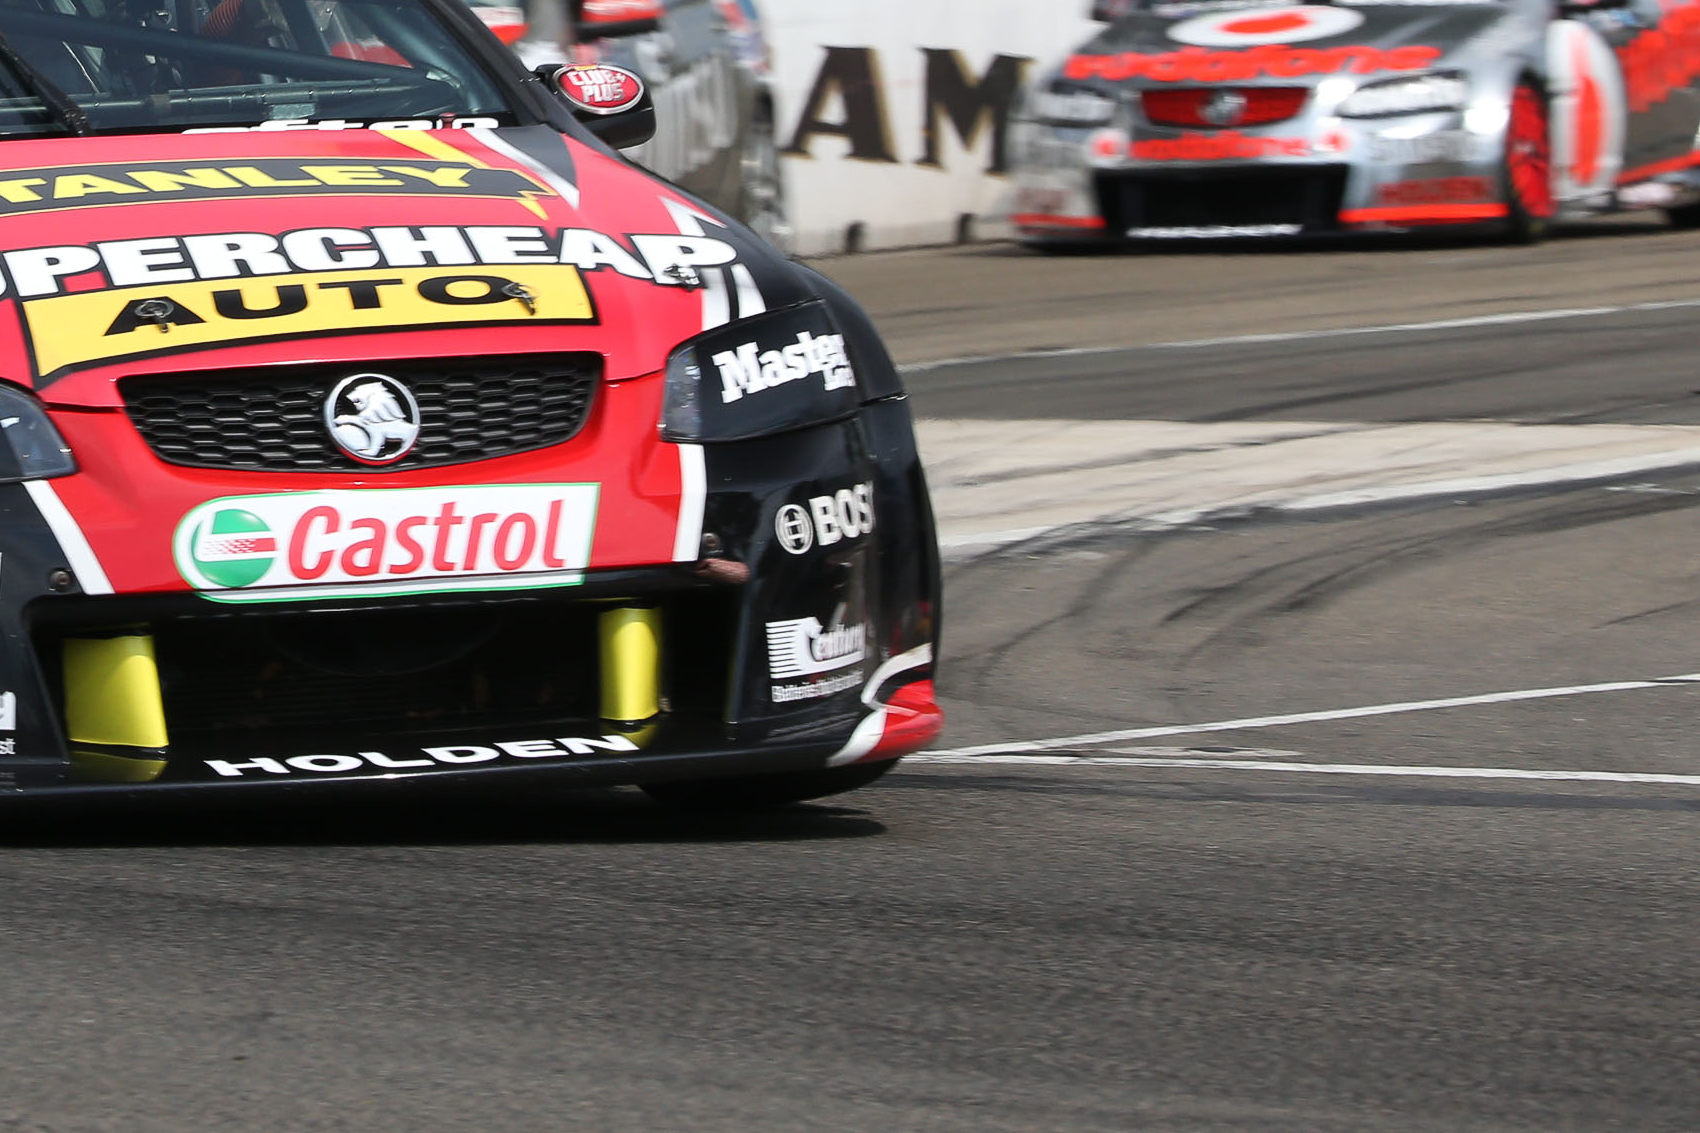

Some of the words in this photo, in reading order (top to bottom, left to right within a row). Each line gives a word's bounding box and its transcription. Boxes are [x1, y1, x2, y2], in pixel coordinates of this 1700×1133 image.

[104, 274, 522, 337] AUTO
[288, 498, 569, 581] Castrol
[808, 481, 876, 547] BOS
[204, 734, 641, 777] HOLDEN
